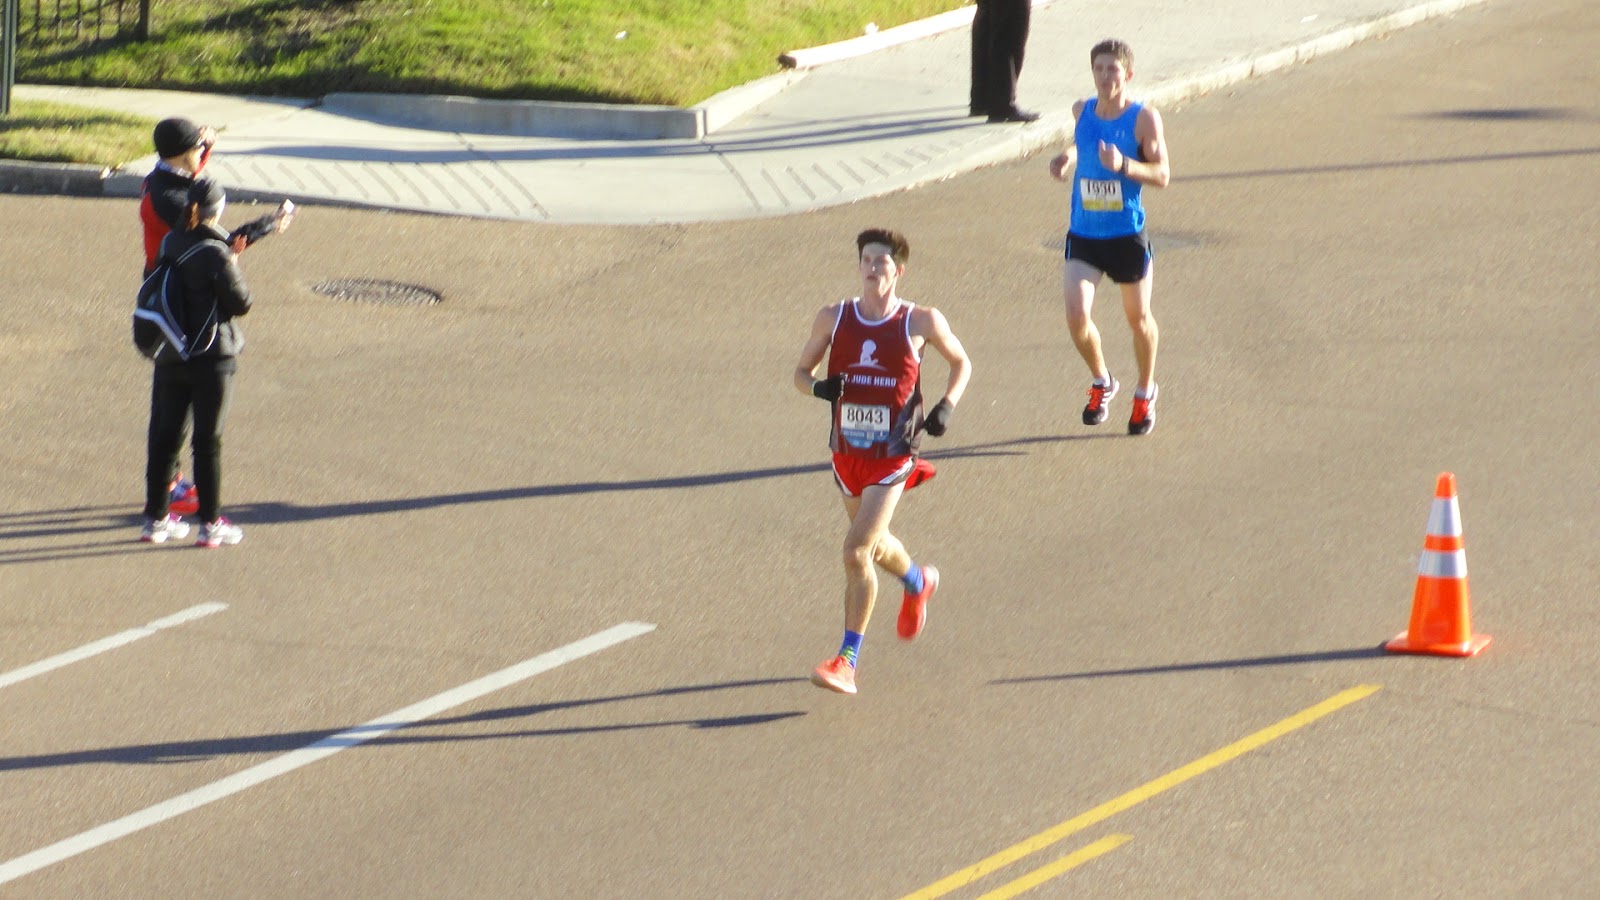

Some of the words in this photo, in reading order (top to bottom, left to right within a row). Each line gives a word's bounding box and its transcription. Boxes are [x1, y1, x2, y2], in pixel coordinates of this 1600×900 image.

[851, 374, 872, 385] JUDE
[873, 376, 897, 388] HERO
[847, 407, 884, 424] 8043
